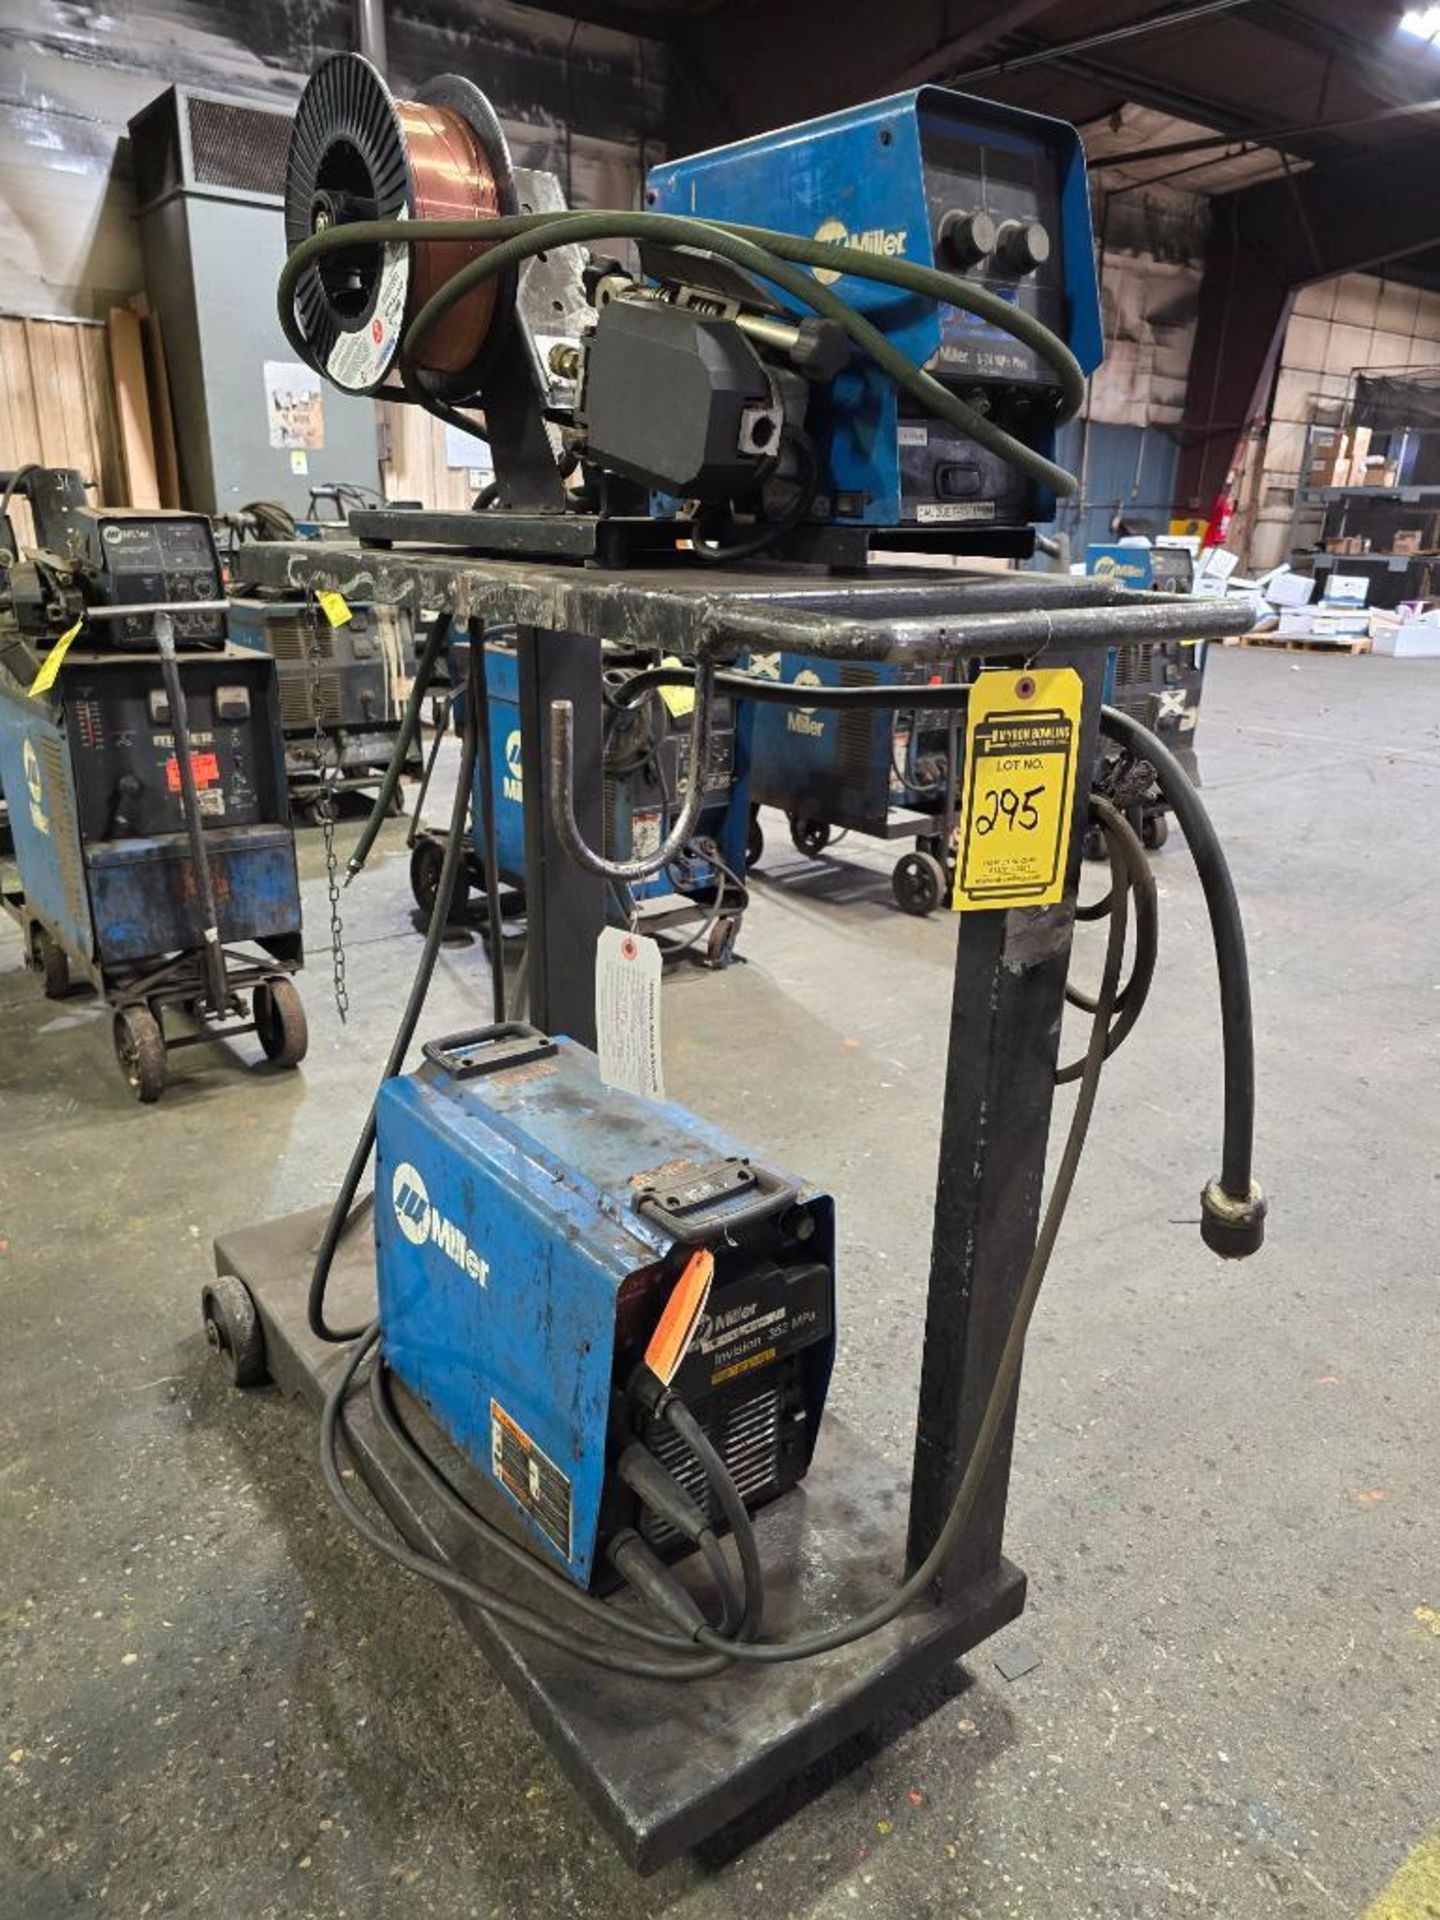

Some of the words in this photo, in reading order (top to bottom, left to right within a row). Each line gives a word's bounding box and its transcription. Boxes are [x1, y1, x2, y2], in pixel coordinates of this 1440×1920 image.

[851, 229, 907, 256] Miller
[787, 711, 825, 737] Miller
[996, 760, 1020, 772] LOT
[1024, 758, 1043, 770] NO.
[976, 785, 1045, 836] 295
[431, 1206, 490, 1288] Miller
[714, 1302, 758, 1333] Miller
[714, 1336, 762, 1365] Invision
